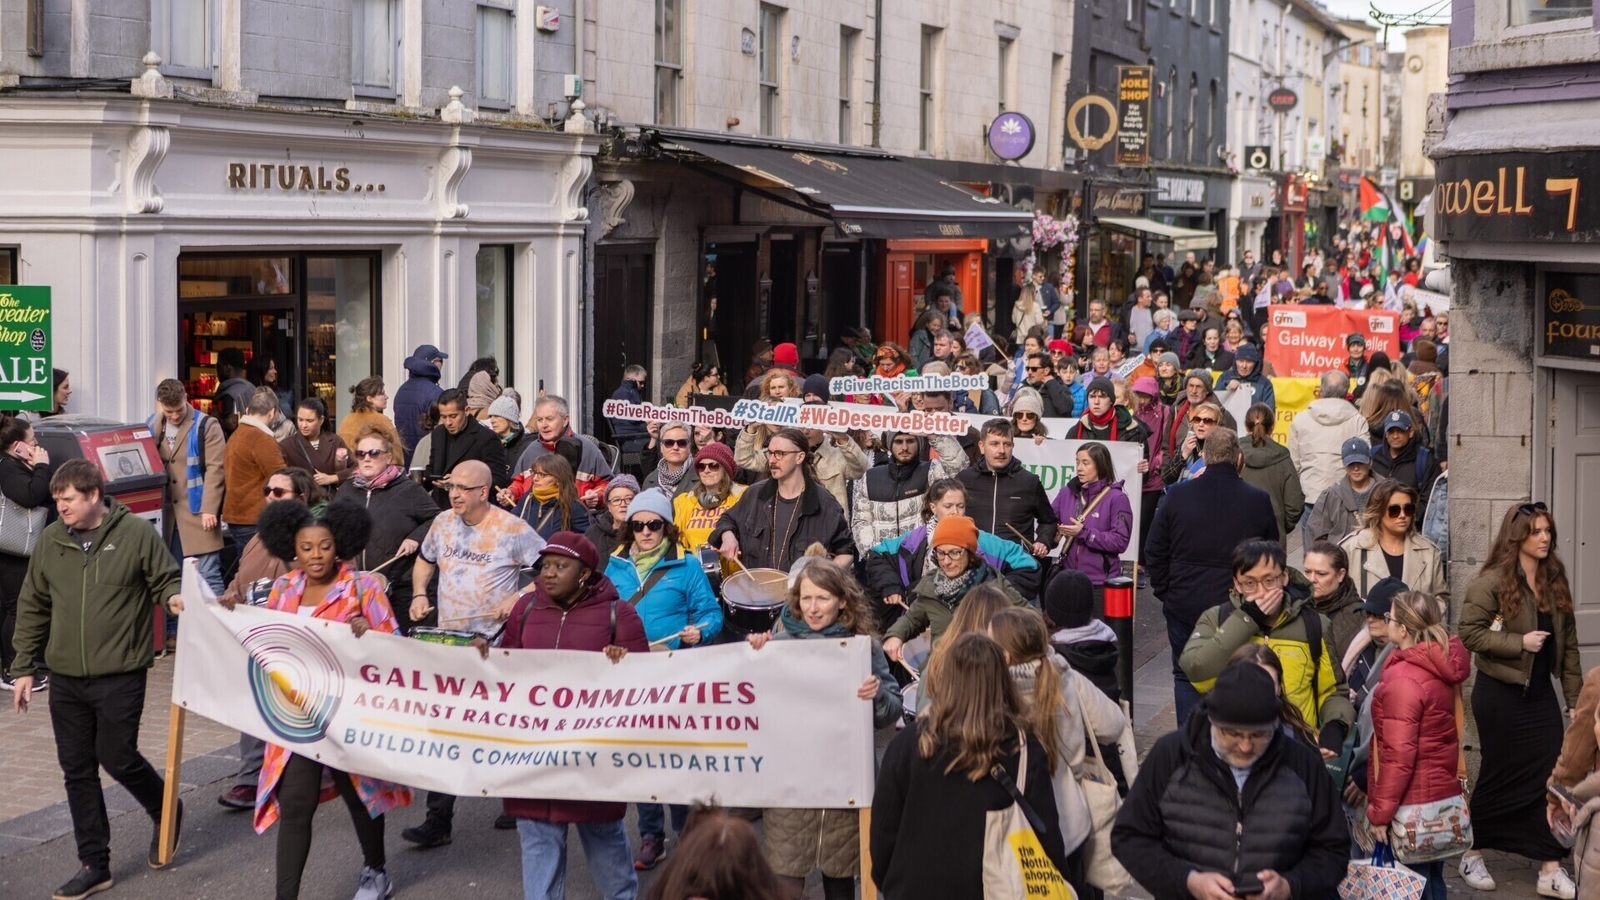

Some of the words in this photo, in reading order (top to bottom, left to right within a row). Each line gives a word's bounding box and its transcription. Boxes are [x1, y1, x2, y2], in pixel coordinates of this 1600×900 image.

[1121, 78, 1148, 88] JOKE
[1121, 90, 1149, 100] SHOP
[1435, 166, 1534, 217] owell
[0, 305, 49, 323] weater
[0, 326, 26, 346] hop
[1278, 330, 1337, 351] Galway
[832, 375, 985, 393] #GiveRacismTheBoot
[734, 401, 798, 424] #StallR
[800, 407, 969, 433] #WeDeserveBetter
[359, 664, 515, 703] GALWAY
[528, 681, 756, 709] COMMUNITIES
[354, 692, 456, 720] AGAINST
[462, 708, 549, 731] RACISM
[554, 718, 567, 731] &
[572, 714, 759, 731] DISCRIMINATION
[344, 728, 461, 760] BUILDING
[472, 748, 598, 766] COMMUNITY
[611, 752, 764, 773] SOLIDARITY
[1018, 846, 1034, 857] the
[1026, 883, 1050, 897] bag.
